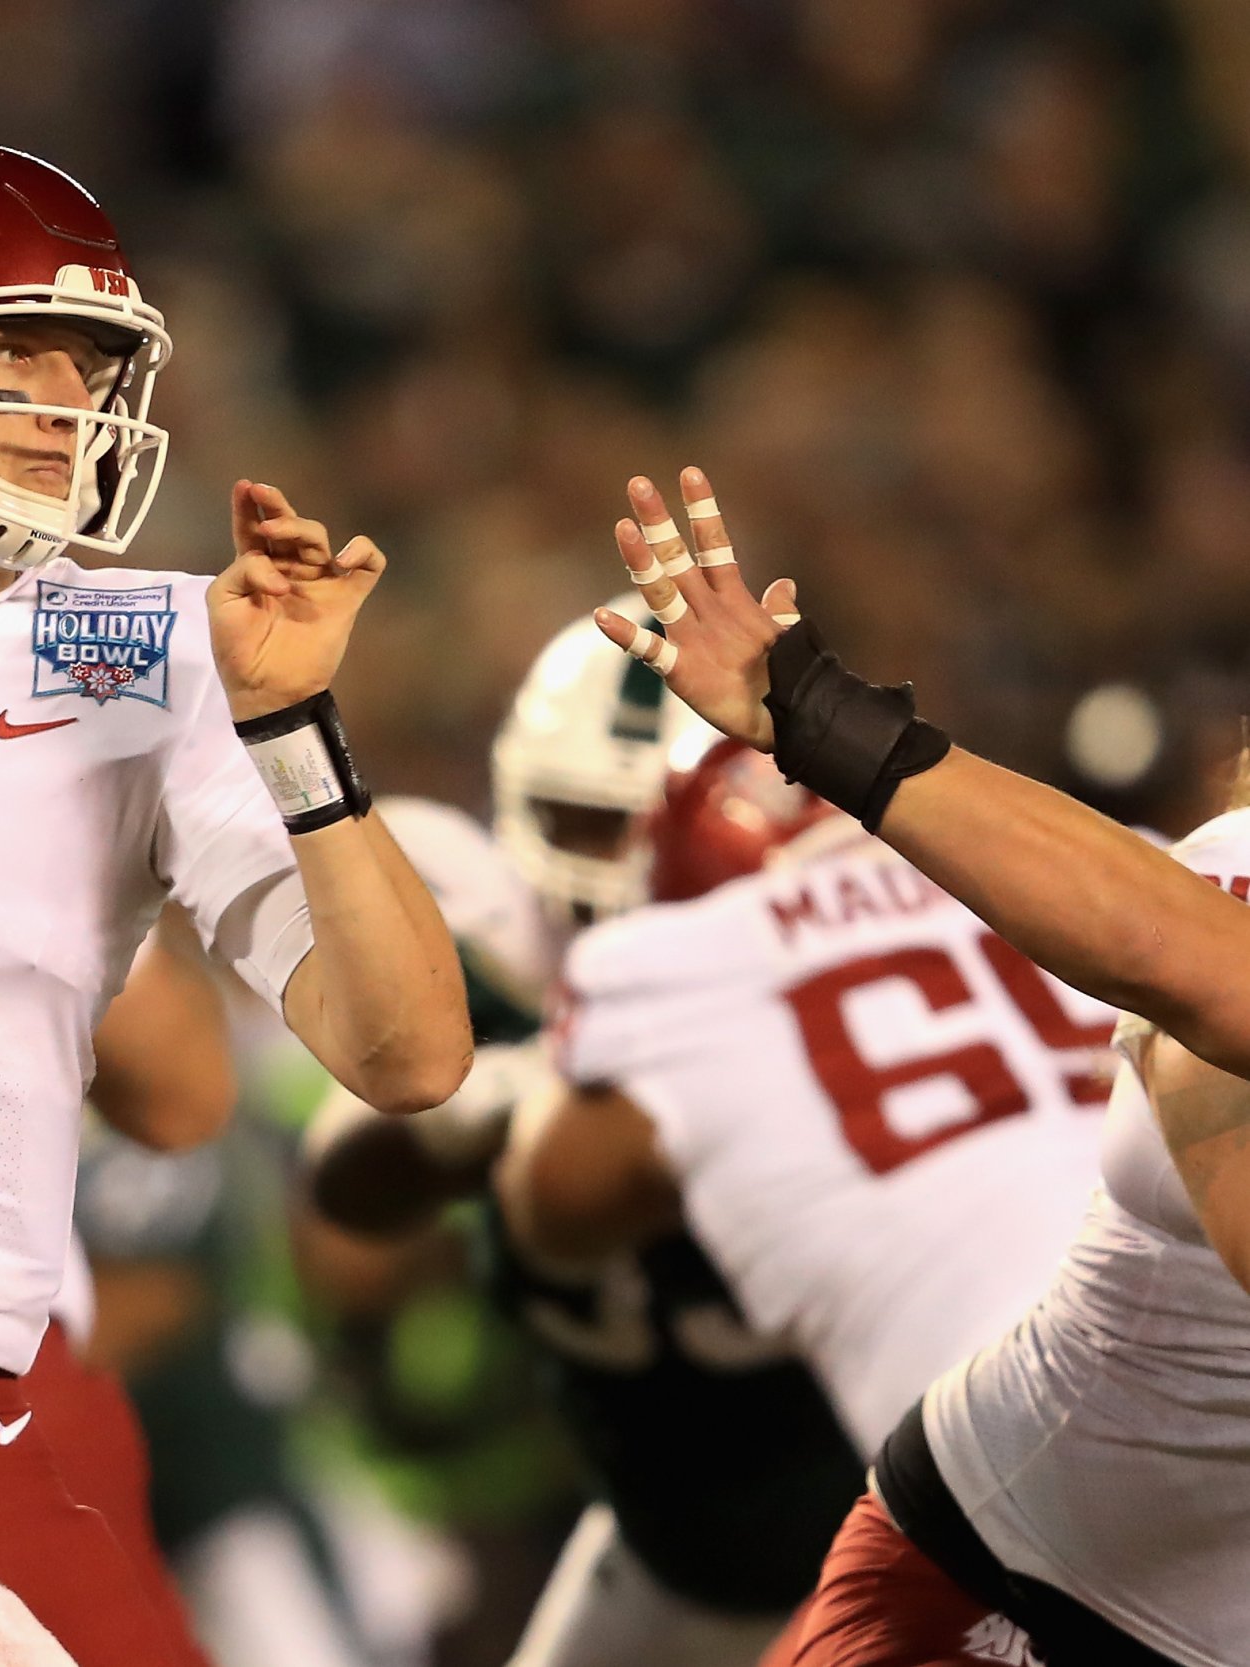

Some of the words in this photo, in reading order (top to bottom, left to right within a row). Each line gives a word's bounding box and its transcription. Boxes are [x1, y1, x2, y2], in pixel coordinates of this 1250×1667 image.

[94, 593, 124, 601] Diego
[126, 593, 163, 601] County
[35, 612, 172, 654] HOLIDAY
[56, 643, 150, 666] BOWL
